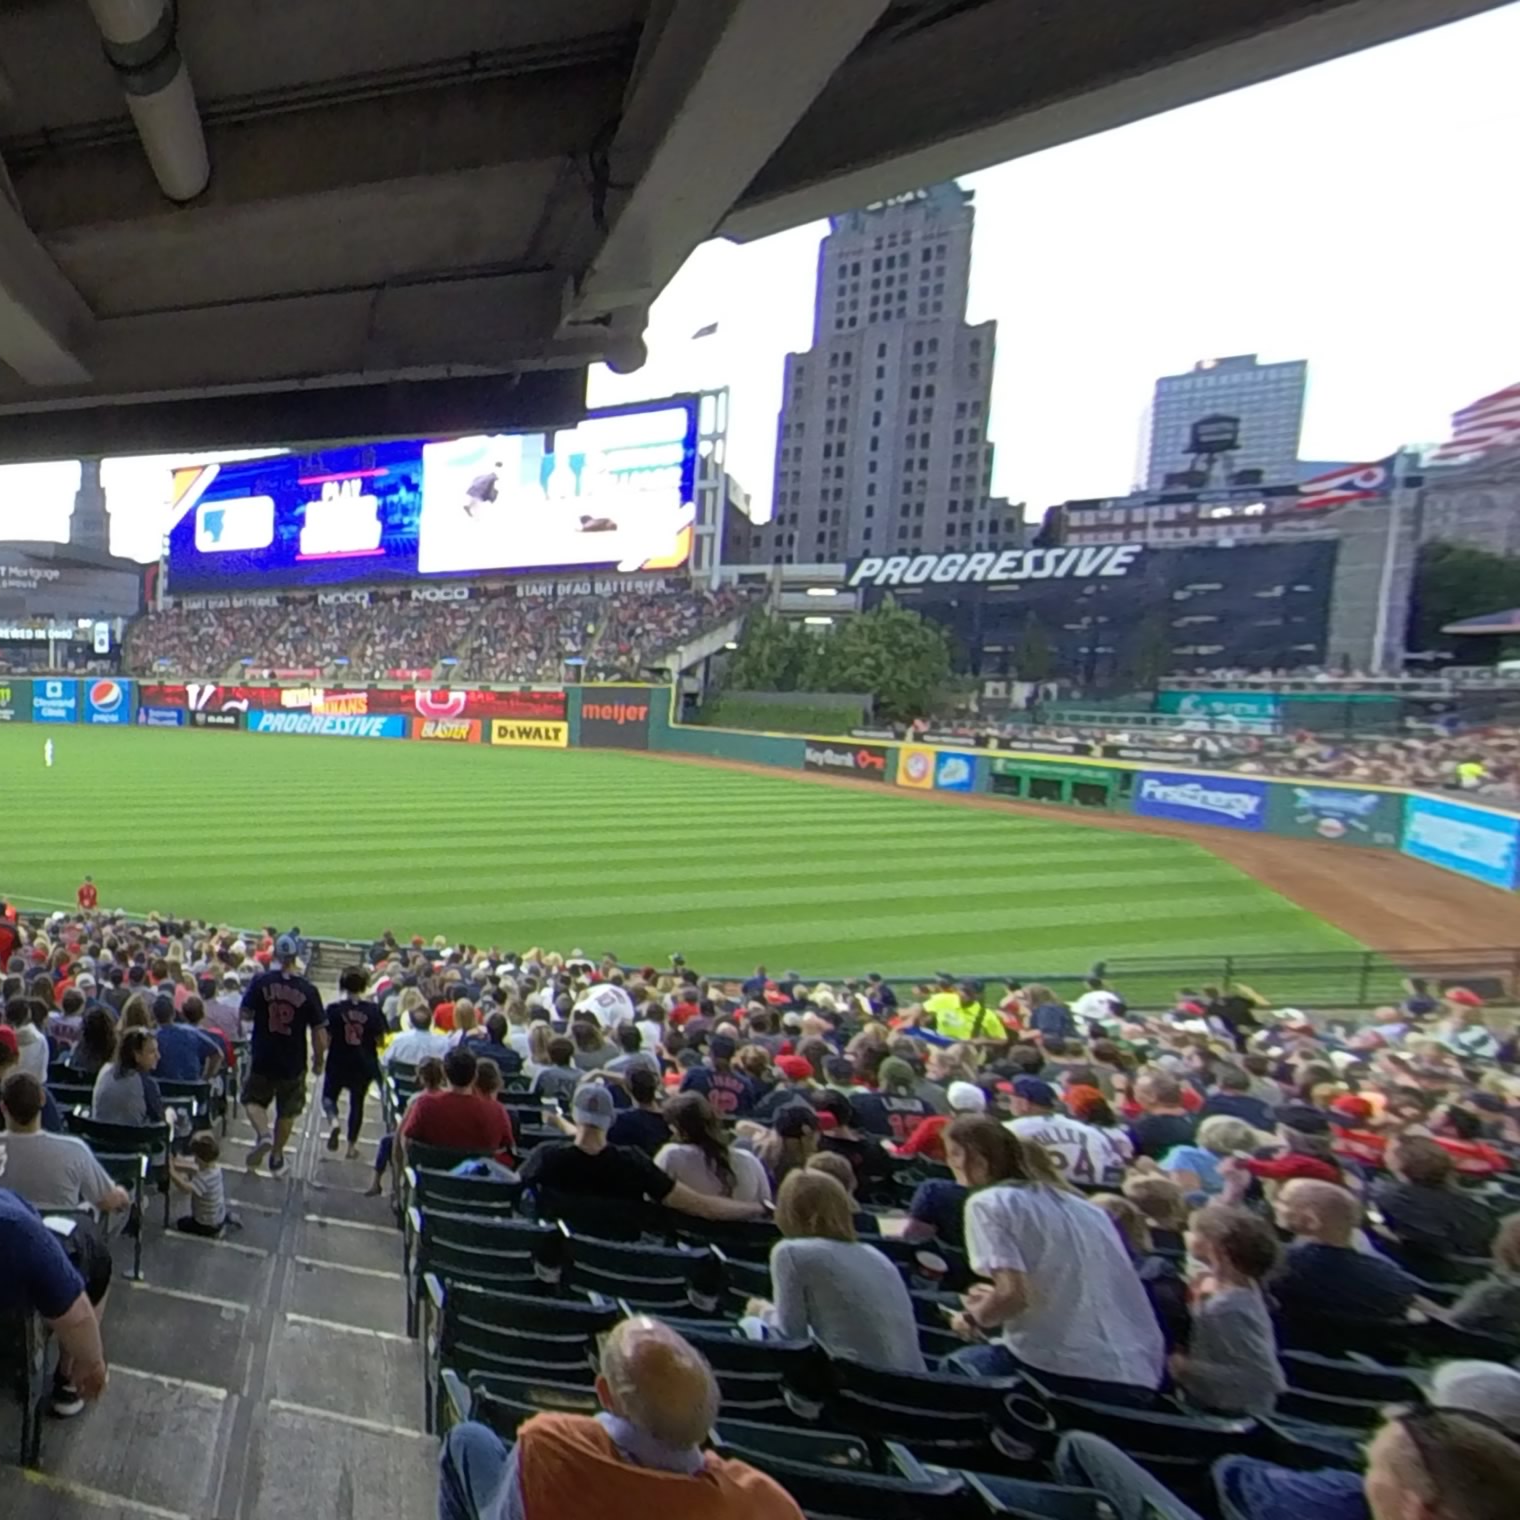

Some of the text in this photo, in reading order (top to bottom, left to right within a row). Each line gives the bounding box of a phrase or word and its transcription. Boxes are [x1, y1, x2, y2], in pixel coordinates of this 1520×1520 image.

[8, 566, 60, 581] Mortgage
[848, 545, 1143, 586] PROGRESSIVE
[317, 591, 369, 608] NOCO
[411, 588, 469, 600] NOCO
[582, 703, 648, 725] meijer
[258, 712, 388, 738] PROGRESSIVE
[421, 720, 471, 740] BLASTER
[805, 749, 854, 769] KeyBank
